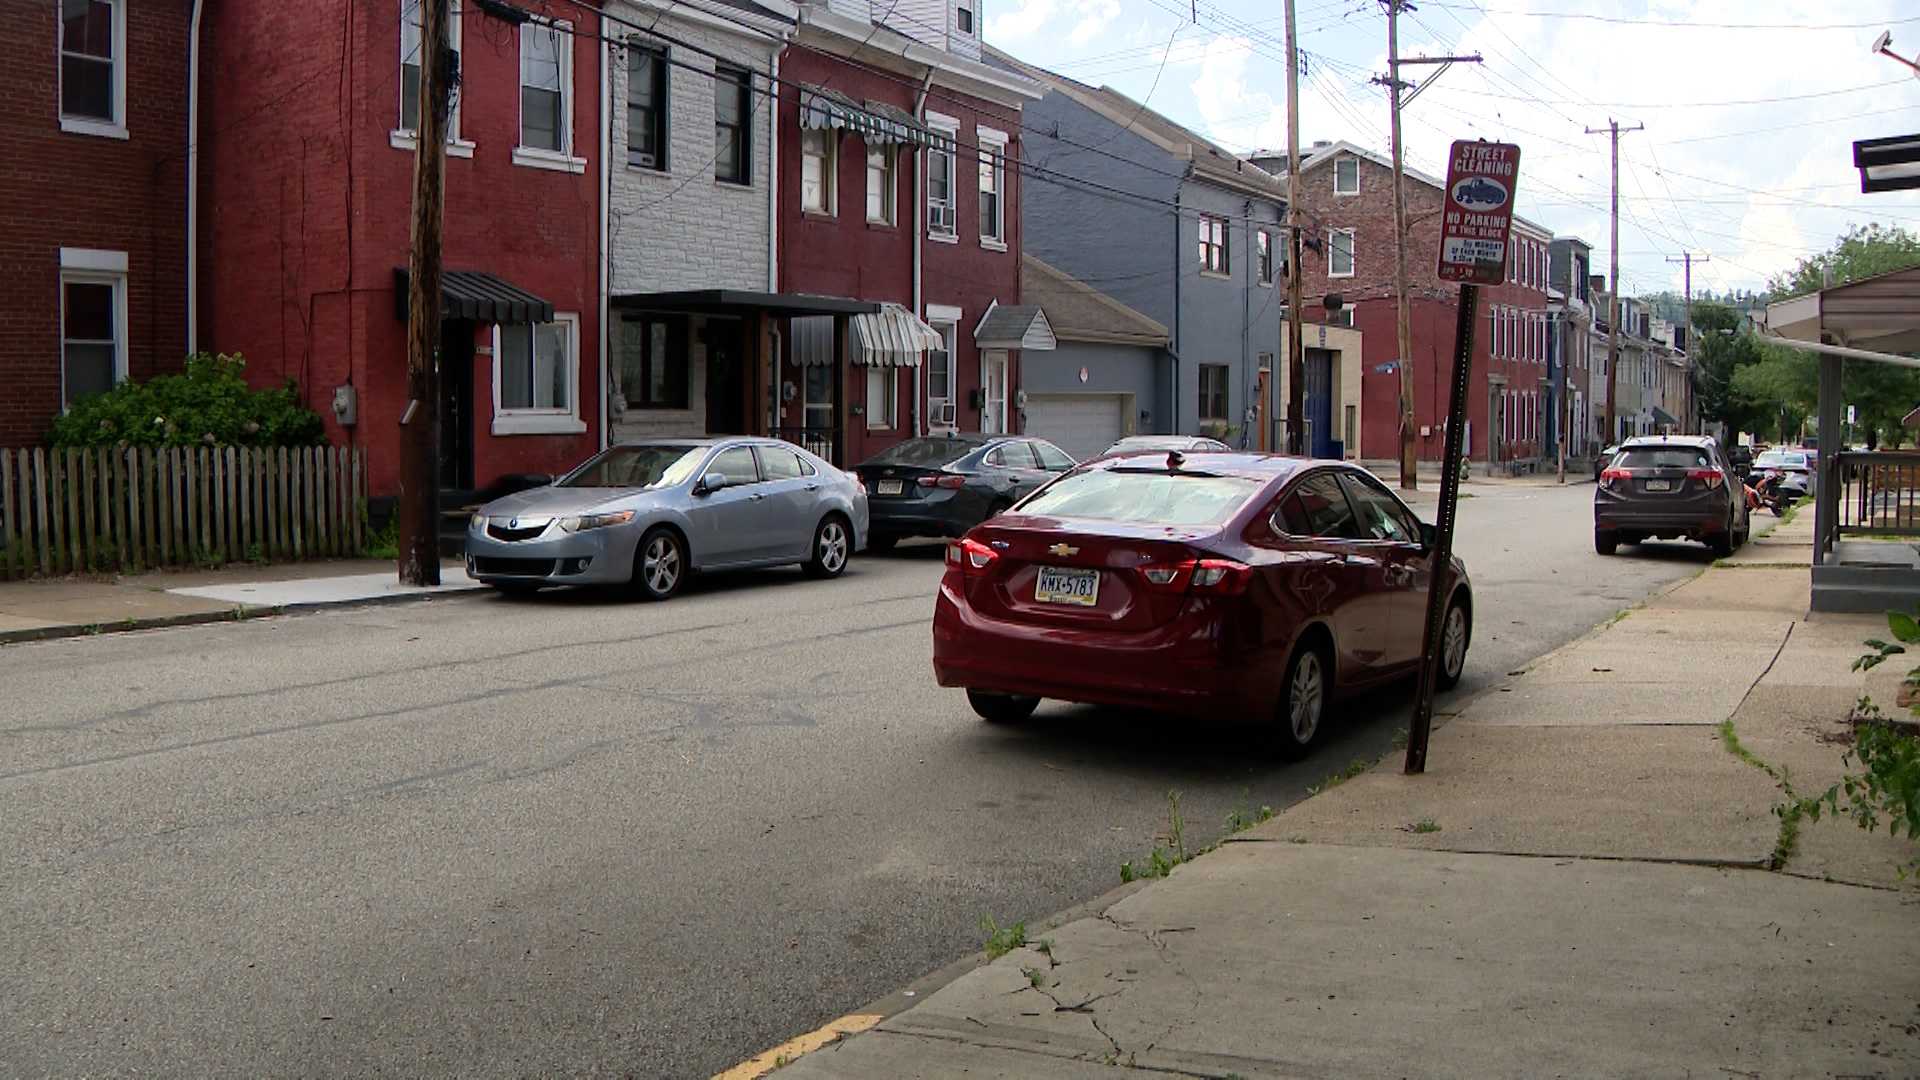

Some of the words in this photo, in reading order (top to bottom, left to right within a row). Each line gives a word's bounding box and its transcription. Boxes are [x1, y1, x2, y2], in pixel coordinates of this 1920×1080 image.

[1462, 145, 1506, 160] STREET
[1454, 159, 1512, 176] CLEANING
[1447, 211, 1460, 224] NO
[1464, 213, 1507, 228] PARKING
[1448, 225, 1457, 233] IN
[1460, 226, 1476, 236] THIS
[1478, 227, 1502, 238] BLOCK
